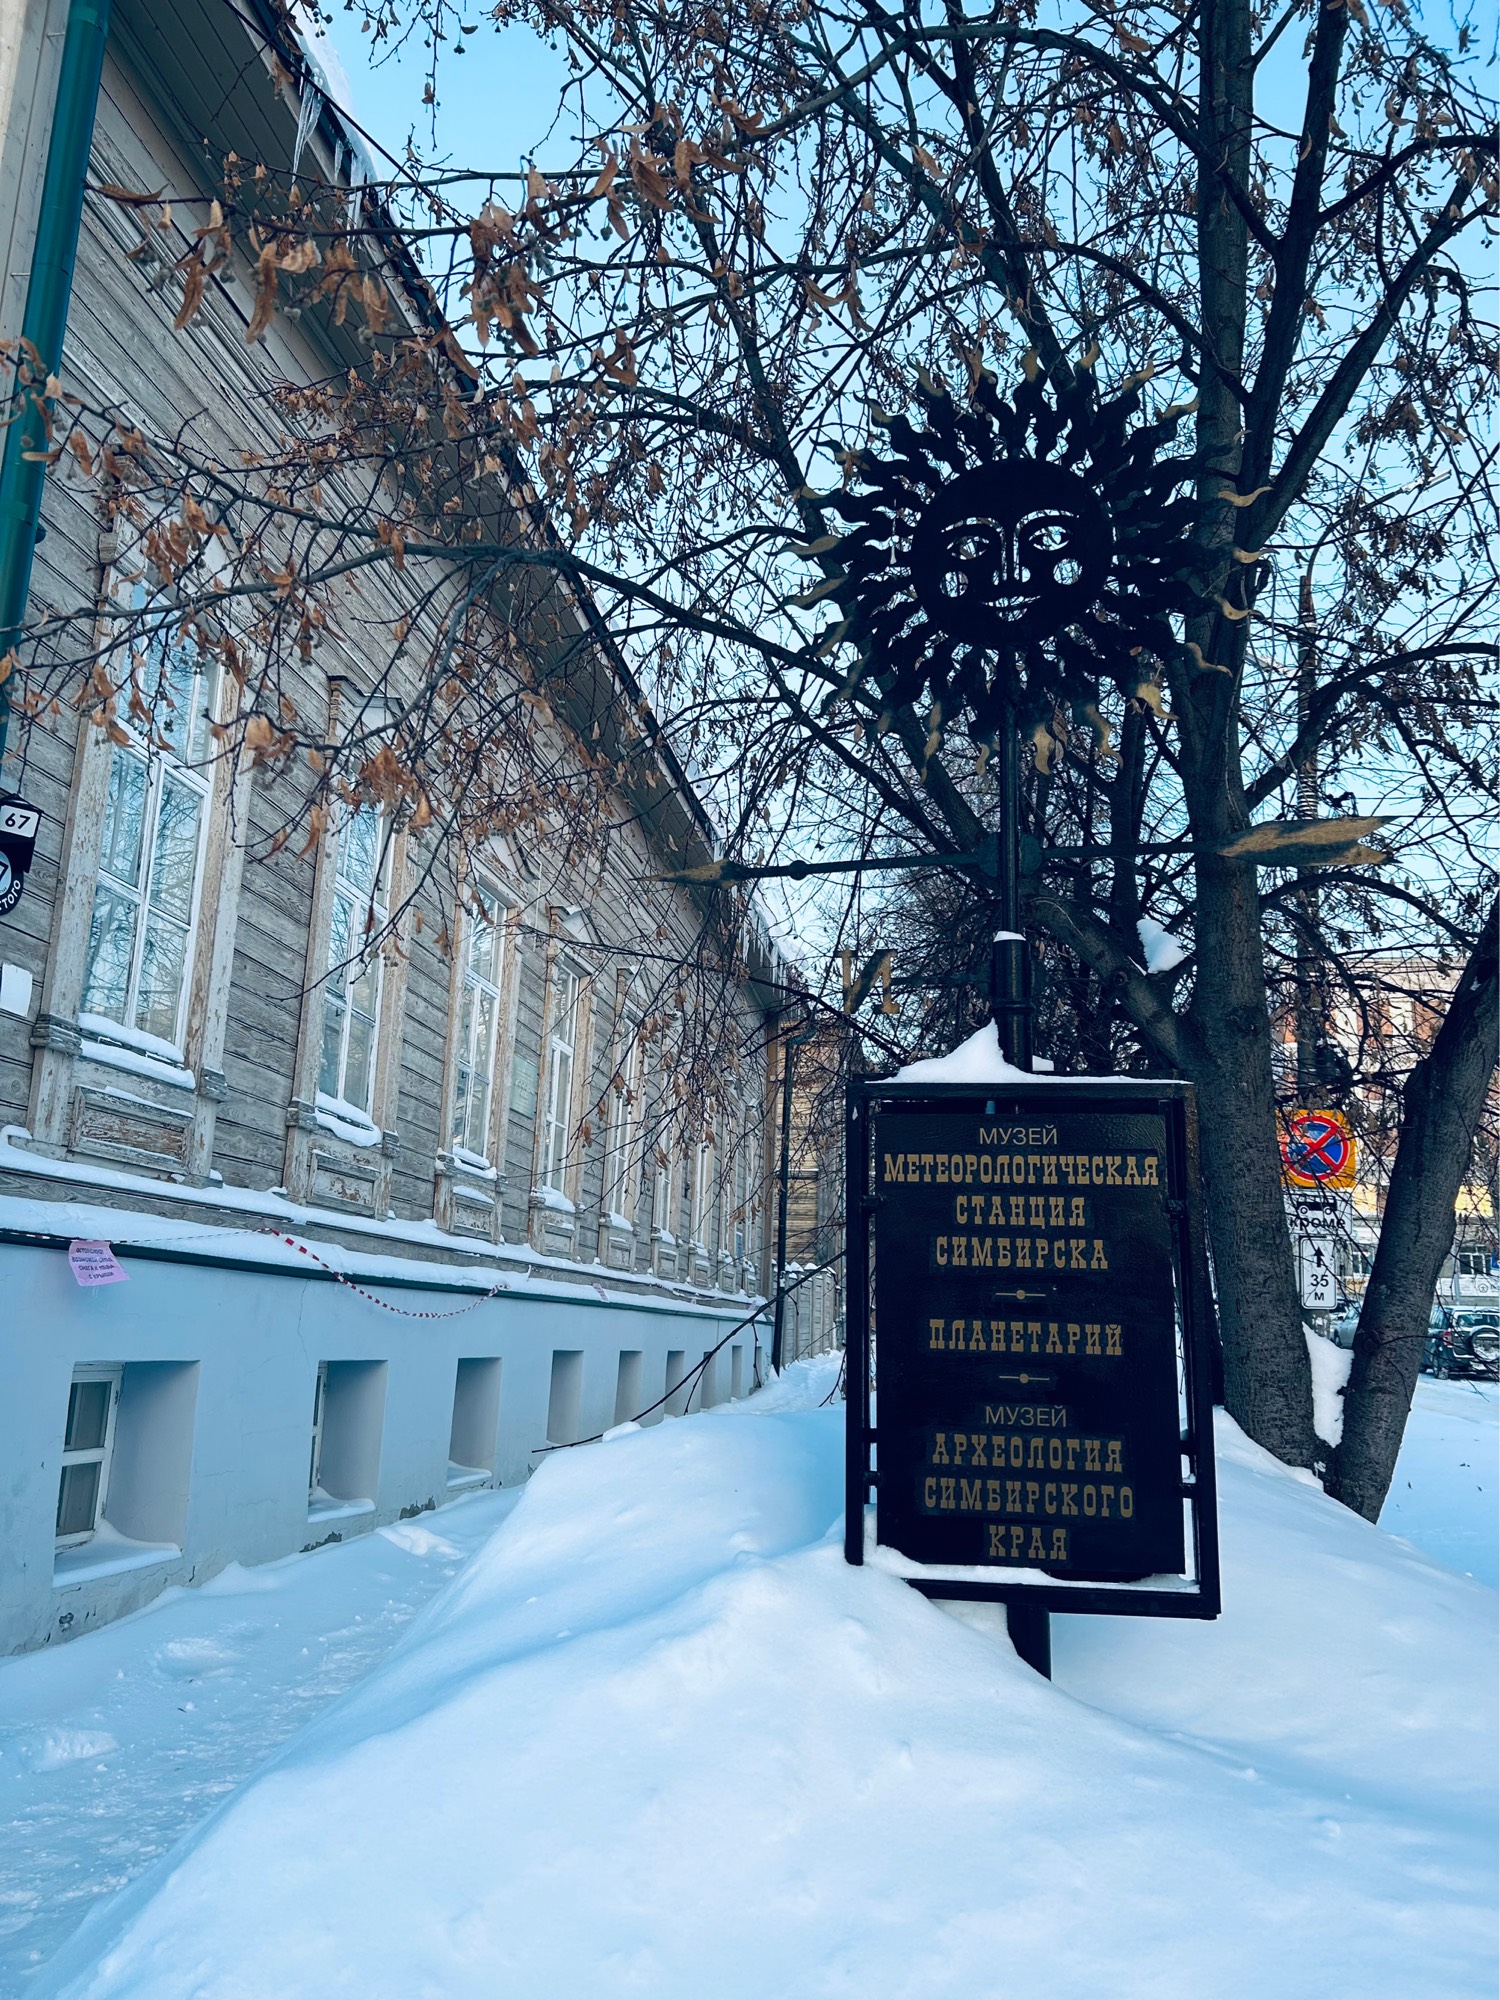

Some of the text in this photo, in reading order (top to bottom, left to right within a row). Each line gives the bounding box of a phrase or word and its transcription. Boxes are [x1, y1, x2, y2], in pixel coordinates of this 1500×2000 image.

[5, 812, 31, 830] 67
[979, 1125, 1058, 1145] МУЗЕЙ
[884, 1154, 1159, 1185] МЕТЕОРОЛОГИЧЕСКАЯ
[956, 1196, 1086, 1230] СТАНЦИЯ
[936, 1236, 1108, 1270] СИМБИРСКА
[1310, 1274, 1329, 1287] 35
[929, 1319, 1122, 1356] ПЛАНЕТАРИЙ
[985, 1405, 1067, 1428] МУЗЕЙ
[932, 1433, 1122, 1473] АРХЕОЛОГИЯ
[925, 1477, 1133, 1518] СИМБИРСКОГО
[989, 1525, 1067, 1560] КРАЯ
